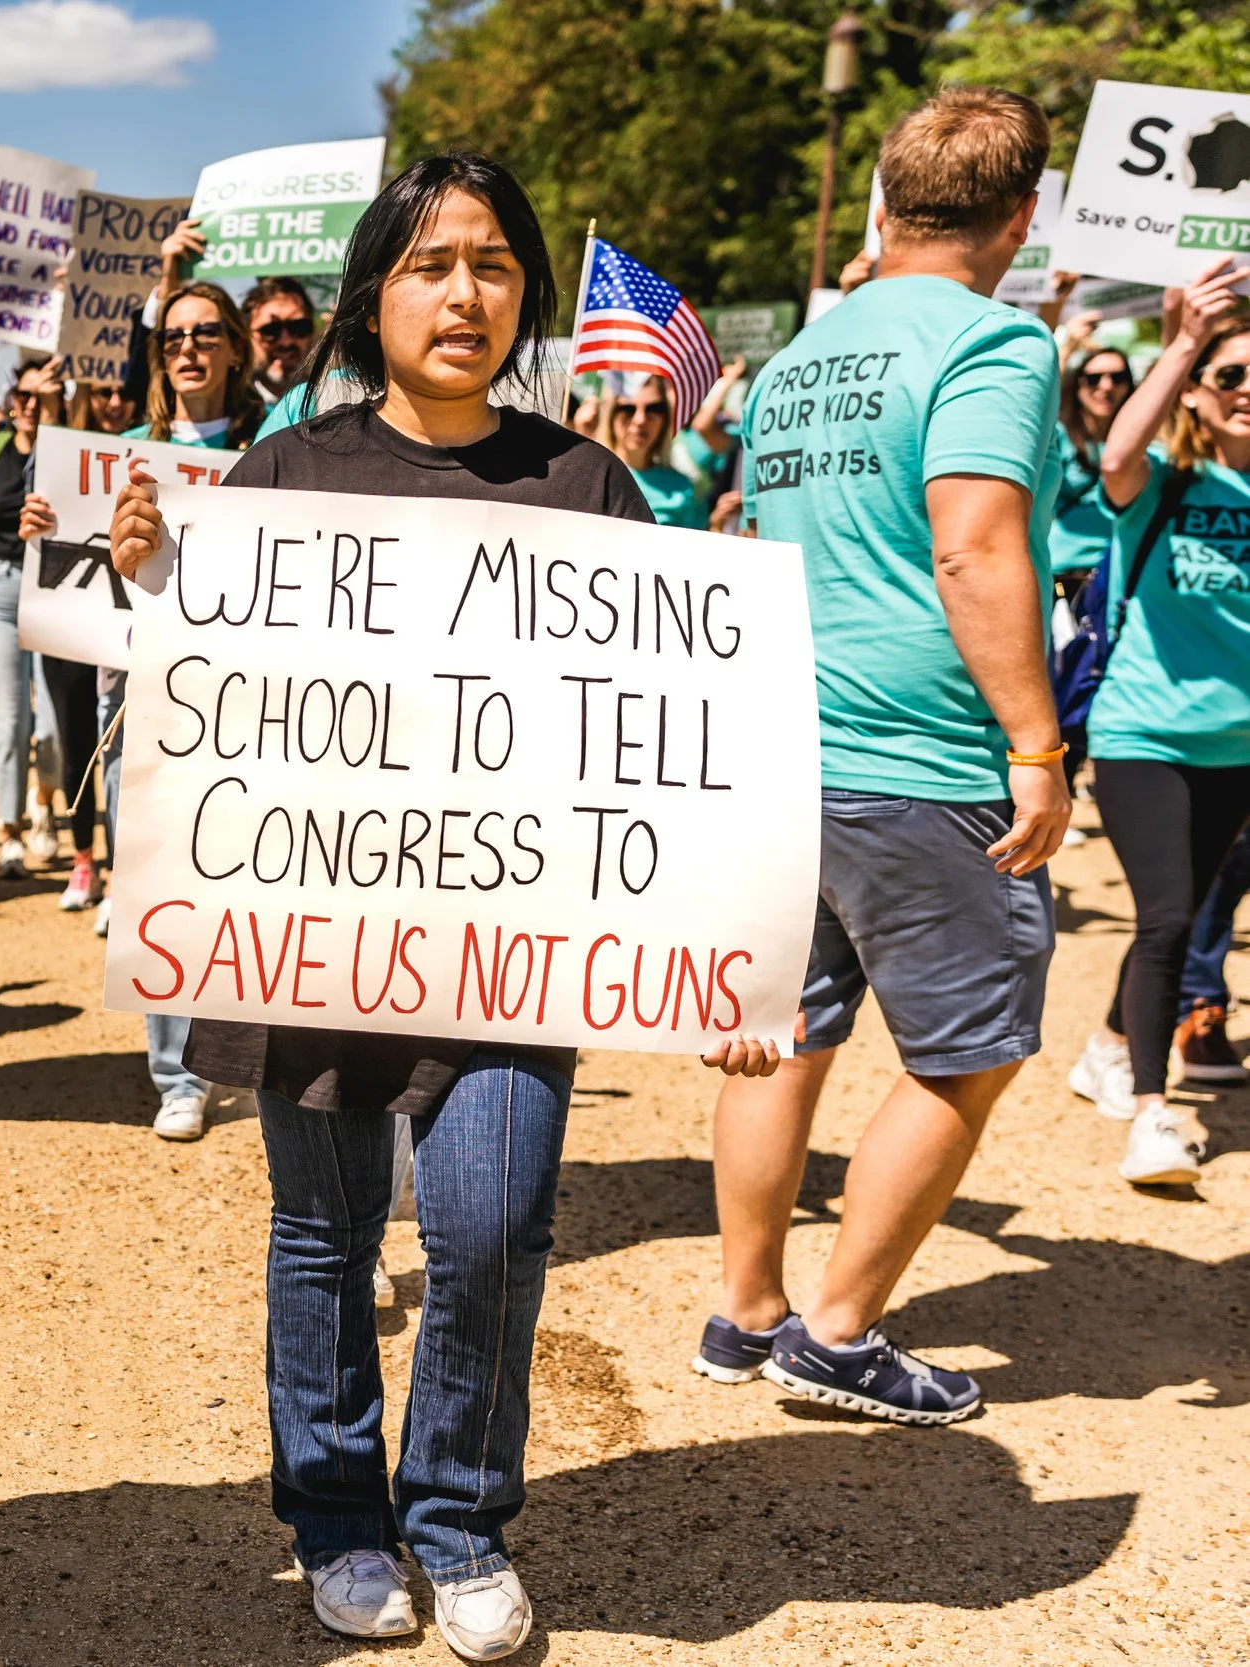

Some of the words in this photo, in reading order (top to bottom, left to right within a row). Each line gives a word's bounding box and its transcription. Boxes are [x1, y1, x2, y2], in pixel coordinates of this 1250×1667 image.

[220, 213, 260, 238] BE
[265, 210, 326, 235] THE
[1076, 208, 1126, 228] Save
[1135, 216, 1175, 235] Our
[200, 237, 350, 269] SOLUTION
[31, 264, 47, 281] A
[70, 282, 143, 320] YOUR
[93, 326, 126, 348] AR
[767, 352, 901, 399] PROTECT
[760, 399, 815, 436] OUR
[823, 391, 884, 425] KIDS
[756, 456, 801, 486] NOT
[177, 524, 400, 635] WE'RE
[448, 537, 741, 660] MISSING
[157, 655, 410, 771] SCHOOL
[433, 673, 514, 774] TO
[561, 676, 732, 791] TELL
[191, 776, 545, 891] CONGRESS
[573, 807, 658, 900] TO
[132, 900, 332, 1008] SAVE
[352, 915, 427, 1015] US
[457, 922, 569, 1025] NOT
[582, 933, 753, 1032] GUNS
